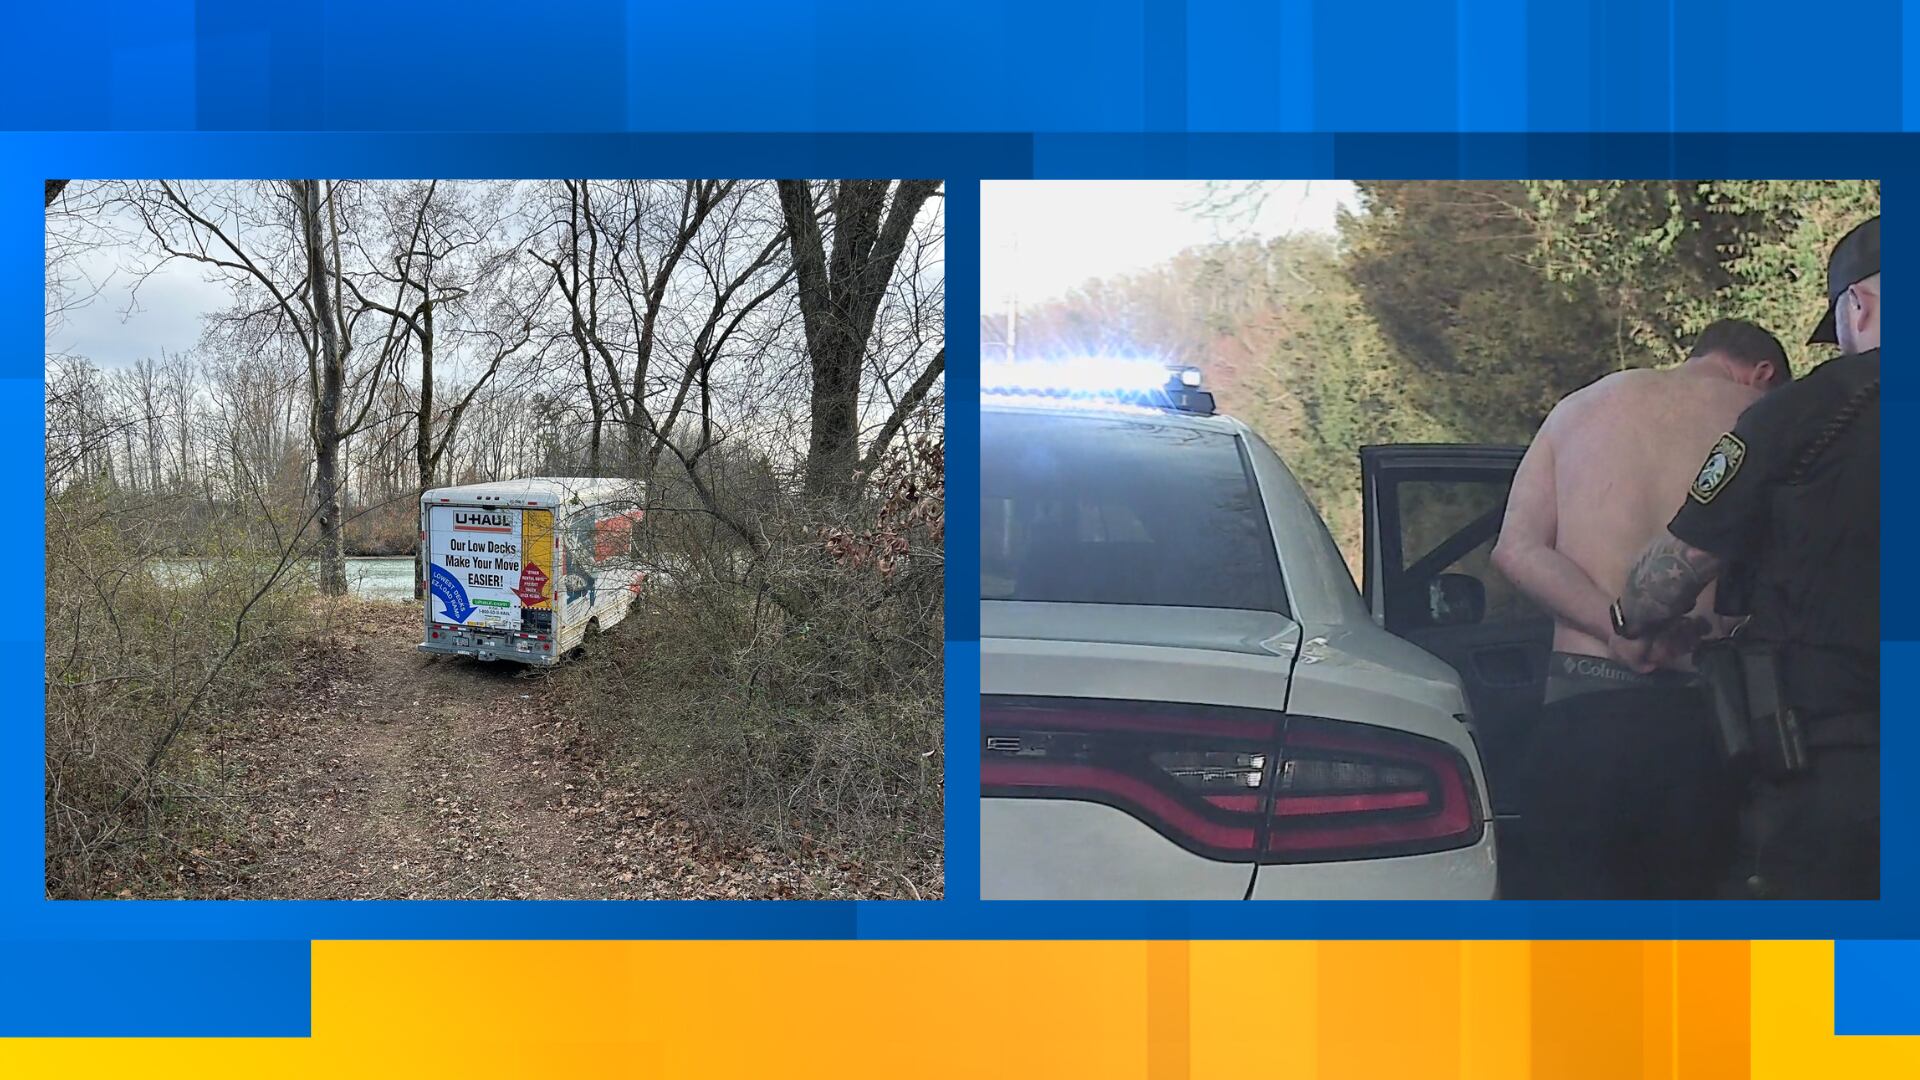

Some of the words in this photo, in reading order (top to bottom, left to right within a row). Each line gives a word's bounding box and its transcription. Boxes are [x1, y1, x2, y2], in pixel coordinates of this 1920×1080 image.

[450, 538, 466, 552] Our
[468, 540, 486, 553] Low
[488, 541, 516, 554] Decks
[445, 554, 470, 568] Make
[472, 556, 492, 570] Your
[494, 558, 519, 571] Move
[433, 571, 456, 590] LOWEST
[468, 573, 504, 587] EASIER!
[1577, 659, 1636, 681] Colum
